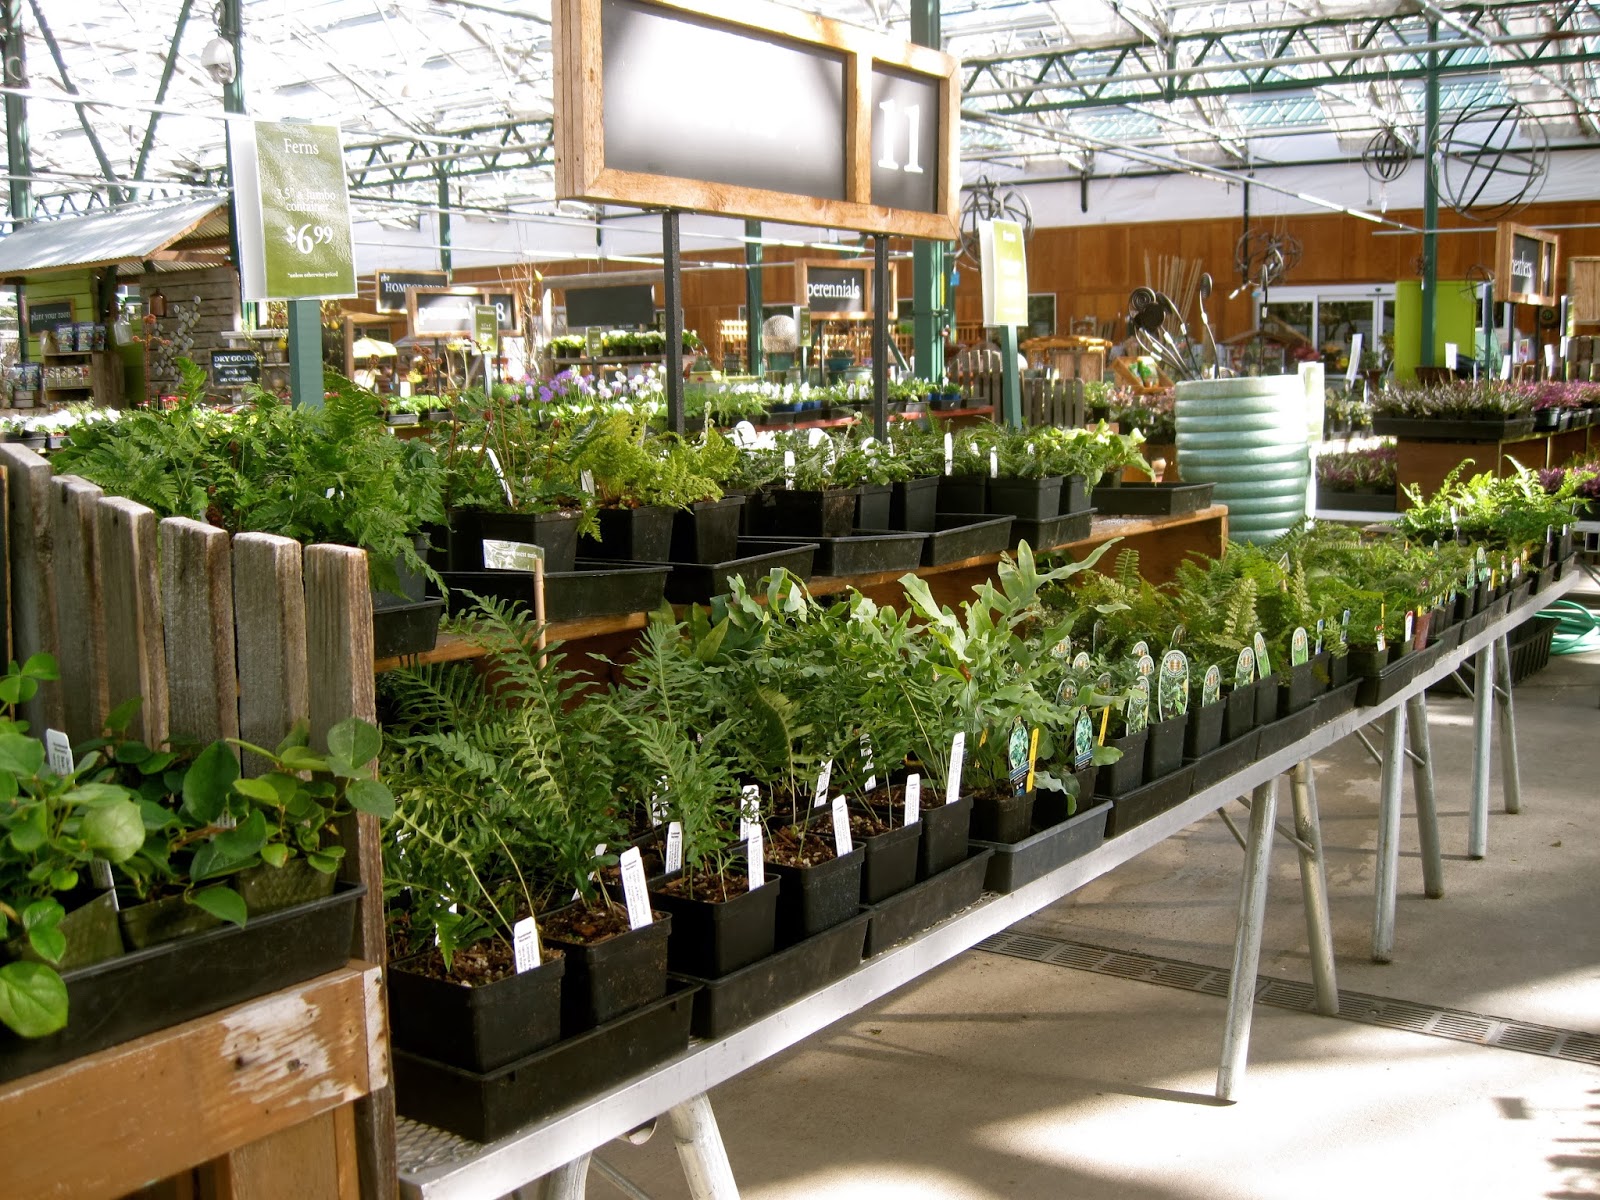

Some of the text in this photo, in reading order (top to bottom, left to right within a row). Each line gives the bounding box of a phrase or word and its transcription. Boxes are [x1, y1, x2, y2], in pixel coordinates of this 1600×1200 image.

[877, 99, 924, 173] 11
[284, 138, 319, 155] Ferns
[286, 201, 330, 212] container
[807, 277, 860, 303] perennials
[31, 311, 44, 324] plant
[496, 302, 506, 321] 8
